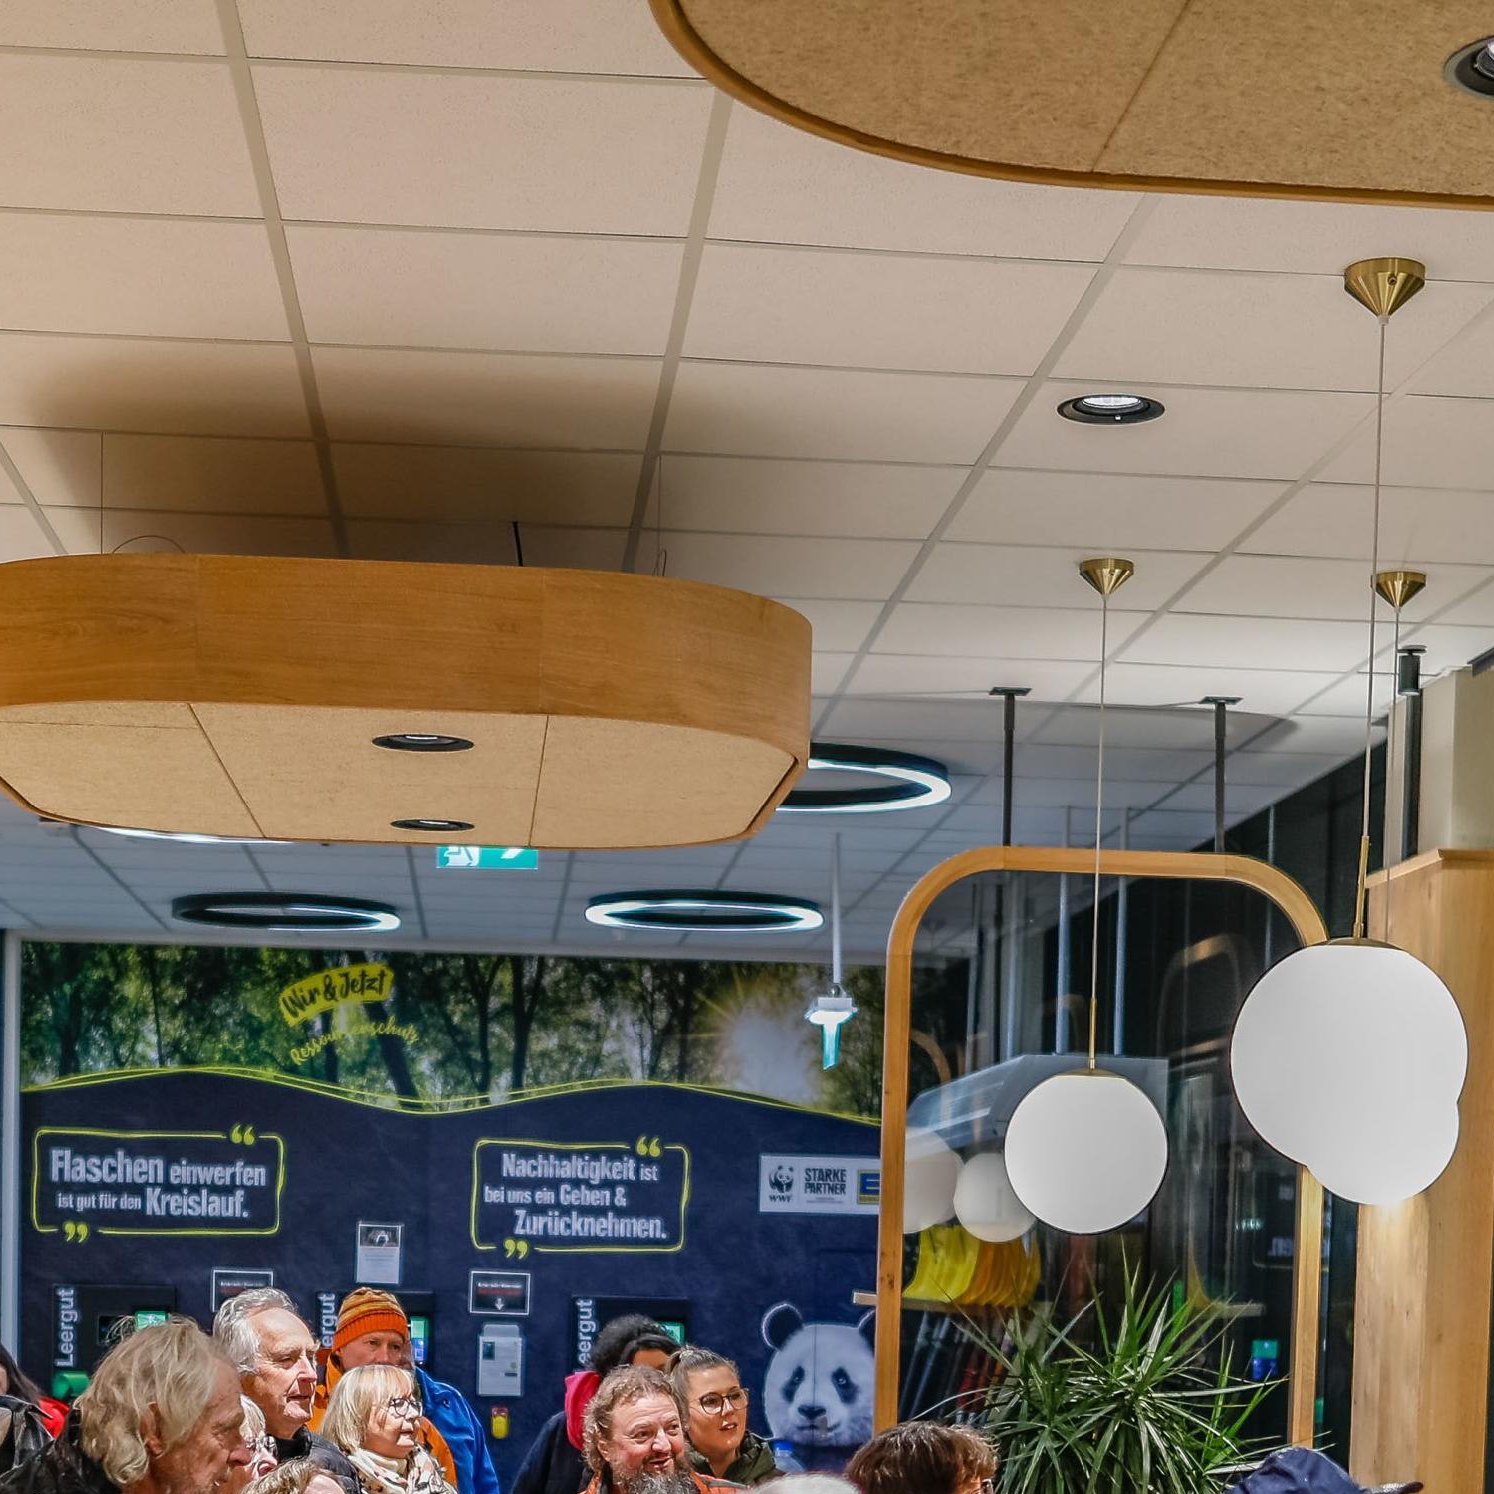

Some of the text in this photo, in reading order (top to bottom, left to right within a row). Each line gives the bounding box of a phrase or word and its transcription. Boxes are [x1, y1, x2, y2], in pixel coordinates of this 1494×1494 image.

[282, 969, 387, 1018] Wir & Jetzt
[50, 1147, 266, 1187] Flaschen einwerfen
[502, 1153, 658, 1184] Nachhaltigkeit ist
[804, 1168, 847, 1183] STARKE
[58, 1187, 249, 1218] ist gut für den Kreislauf.
[484, 1184, 627, 1207] bei uns ein Geben &
[769, 1194, 793, 1203] WWF
[804, 1183, 847, 1196] PARTNER
[514, 1209, 668, 1239] Zurücknehmen.
[56, 1289, 78, 1367] Leergut
[318, 1293, 338, 1347] ergut
[576, 1299, 597, 1365] eergut
